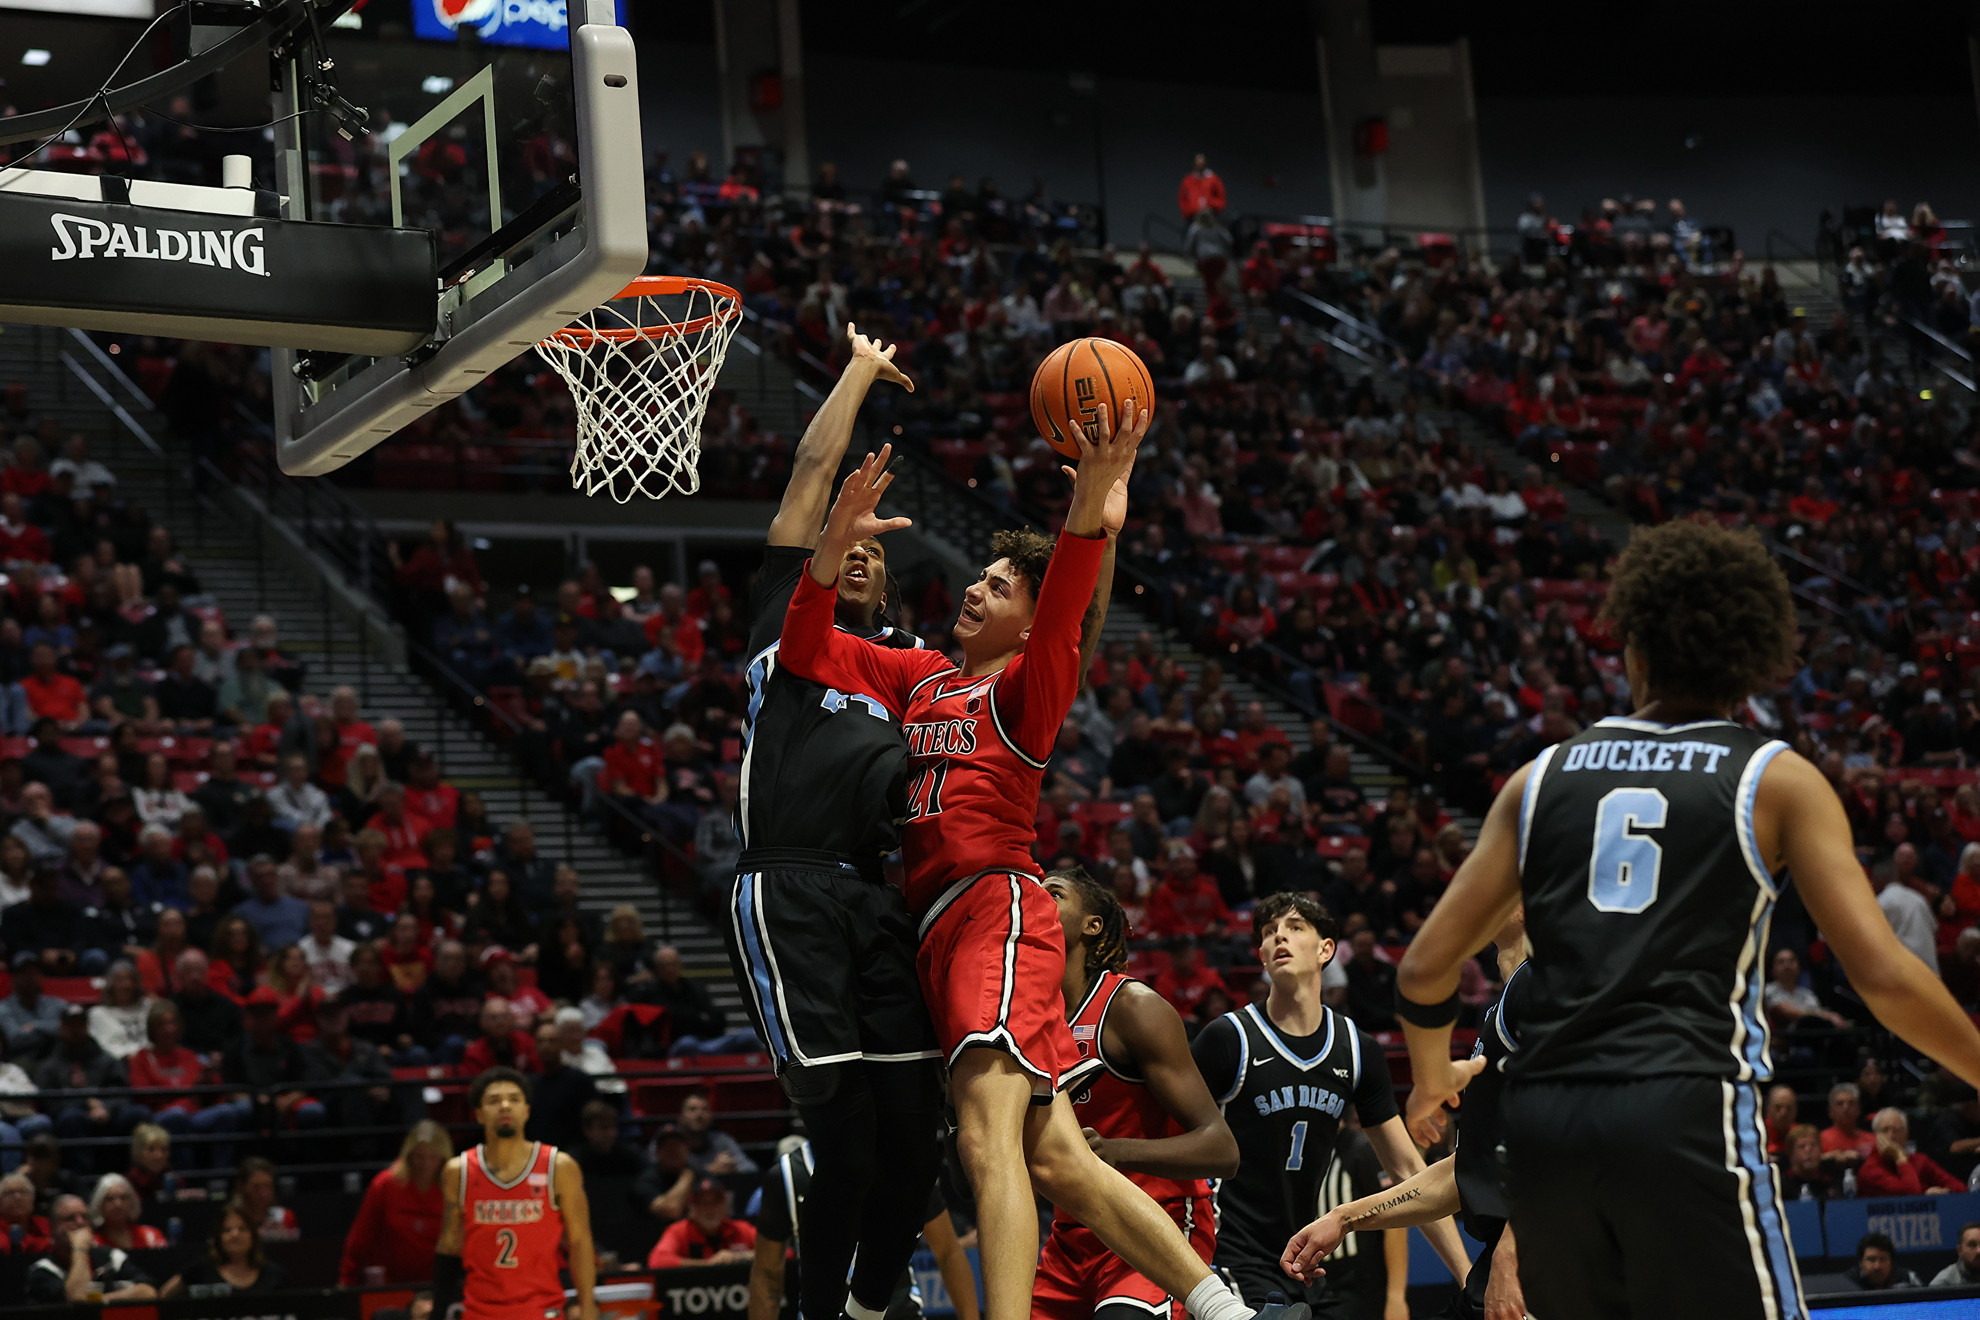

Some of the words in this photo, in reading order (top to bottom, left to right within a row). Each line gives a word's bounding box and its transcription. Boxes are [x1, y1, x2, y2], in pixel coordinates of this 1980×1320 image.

[51, 212, 271, 277] SPALDING
[903, 718, 978, 758] ZTECS
[1562, 740, 1731, 774] DUCKETT
[904, 758, 949, 824] 21
[1587, 787, 1669, 914] 6
[1254, 1085, 1295, 1117] SAN
[1298, 1084, 1345, 1119] DIEGO
[1285, 1120, 1308, 1171] 1
[494, 1227, 519, 1268] 2
[666, 1283, 750, 1316] TOYO
